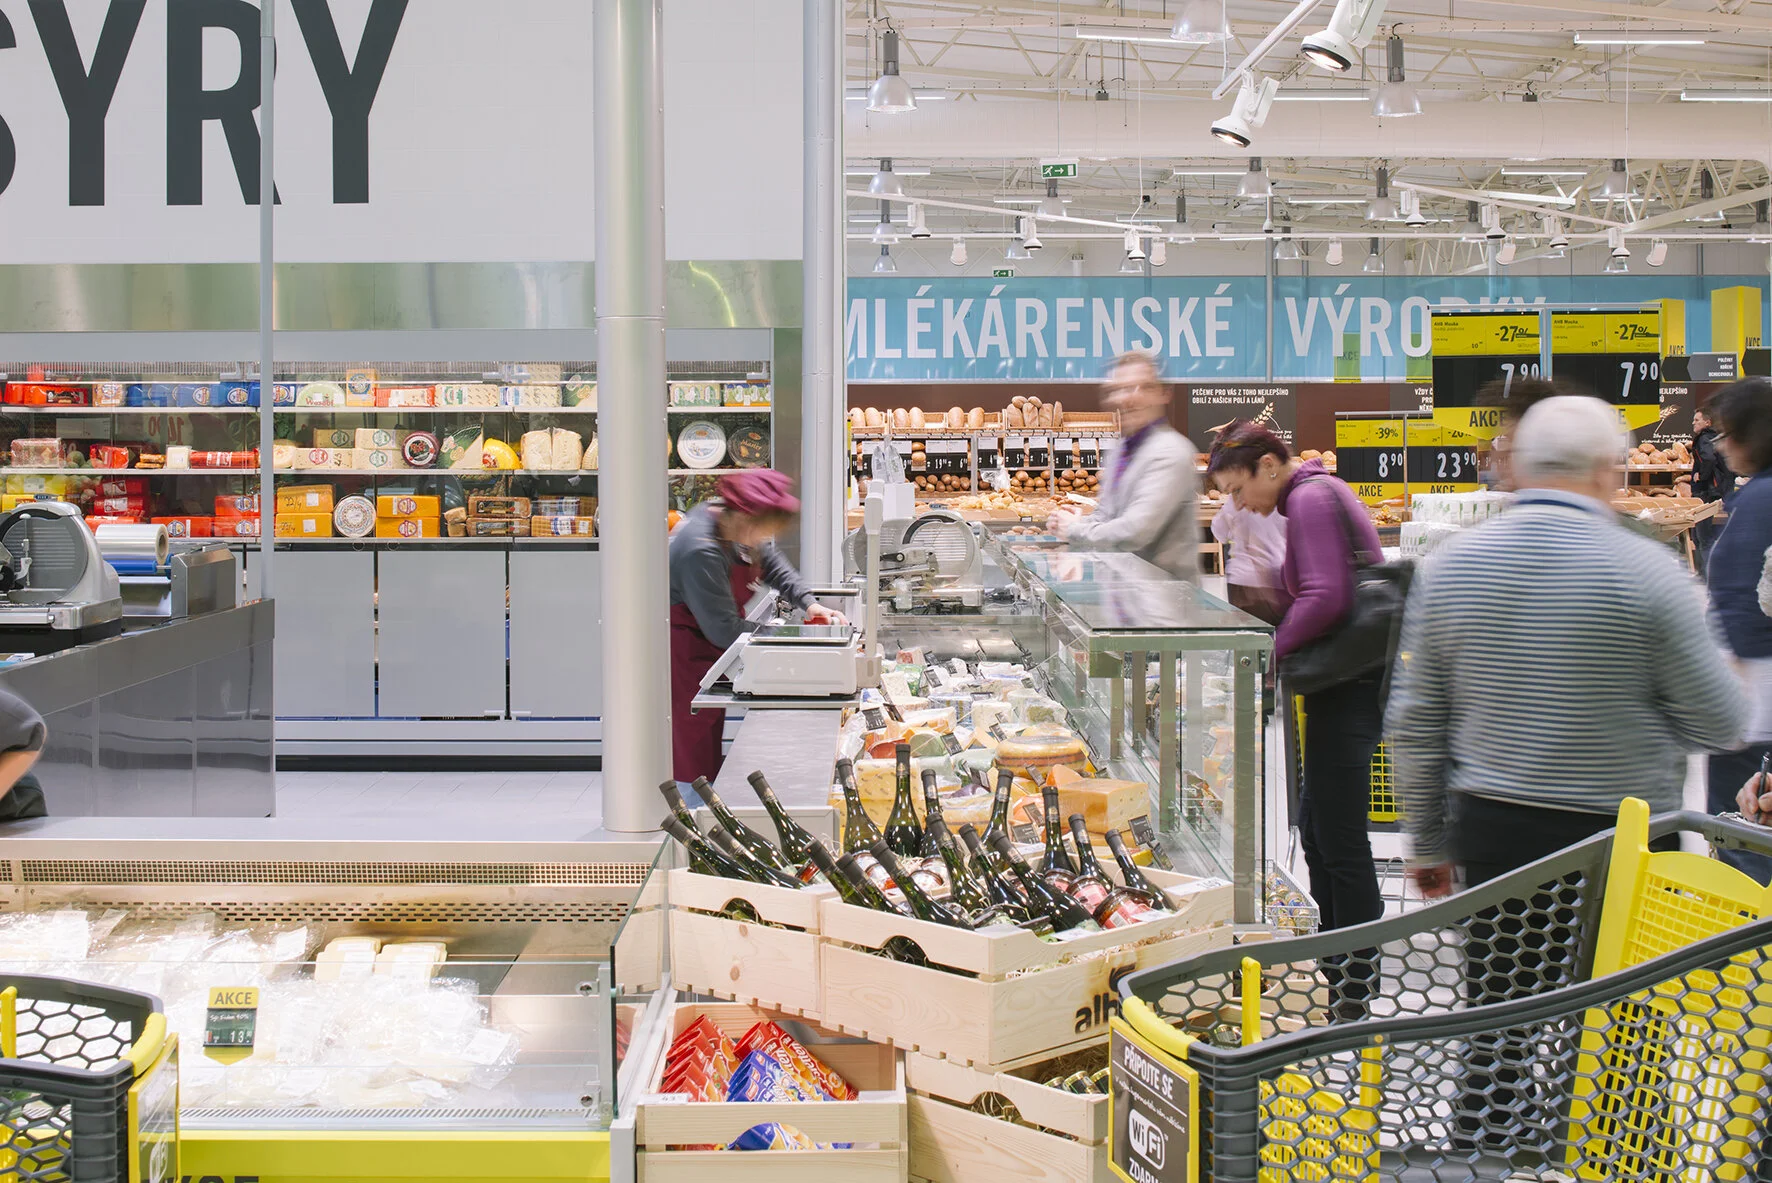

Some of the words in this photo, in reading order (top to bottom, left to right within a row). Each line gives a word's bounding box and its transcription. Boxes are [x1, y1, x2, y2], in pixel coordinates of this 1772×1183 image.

[1286, 283, 1546, 358] VÝRO
[1192, 388, 1214, 396] PEČEME
[1227, 388, 1237, 396] VÁS
[1258, 388, 1289, 396] NEJLEPŠÍHO
[1620, 361, 1634, 398] 7
[1639, 361, 1659, 381] 90
[1192, 396, 1207, 404] OBILÍ
[1213, 396, 1232, 404] NAŠICH
[1233, 396, 1246, 404] POLÍ
[1375, 427, 1399, 439] -39%
[1379, 453, 1389, 478] 8
[1390, 453, 1403, 466] 90
[1437, 452, 1461, 478] 23
[1463, 452, 1477, 466] 90
[1358, 485, 1383, 497] AKCE
[214, 991, 253, 1005] AKCE
[1124, 1045, 1160, 1090] PŘIPOJTE
[1161, 1073, 1174, 1100] SE
[1129, 1156, 1161, 1183] ZDAR
